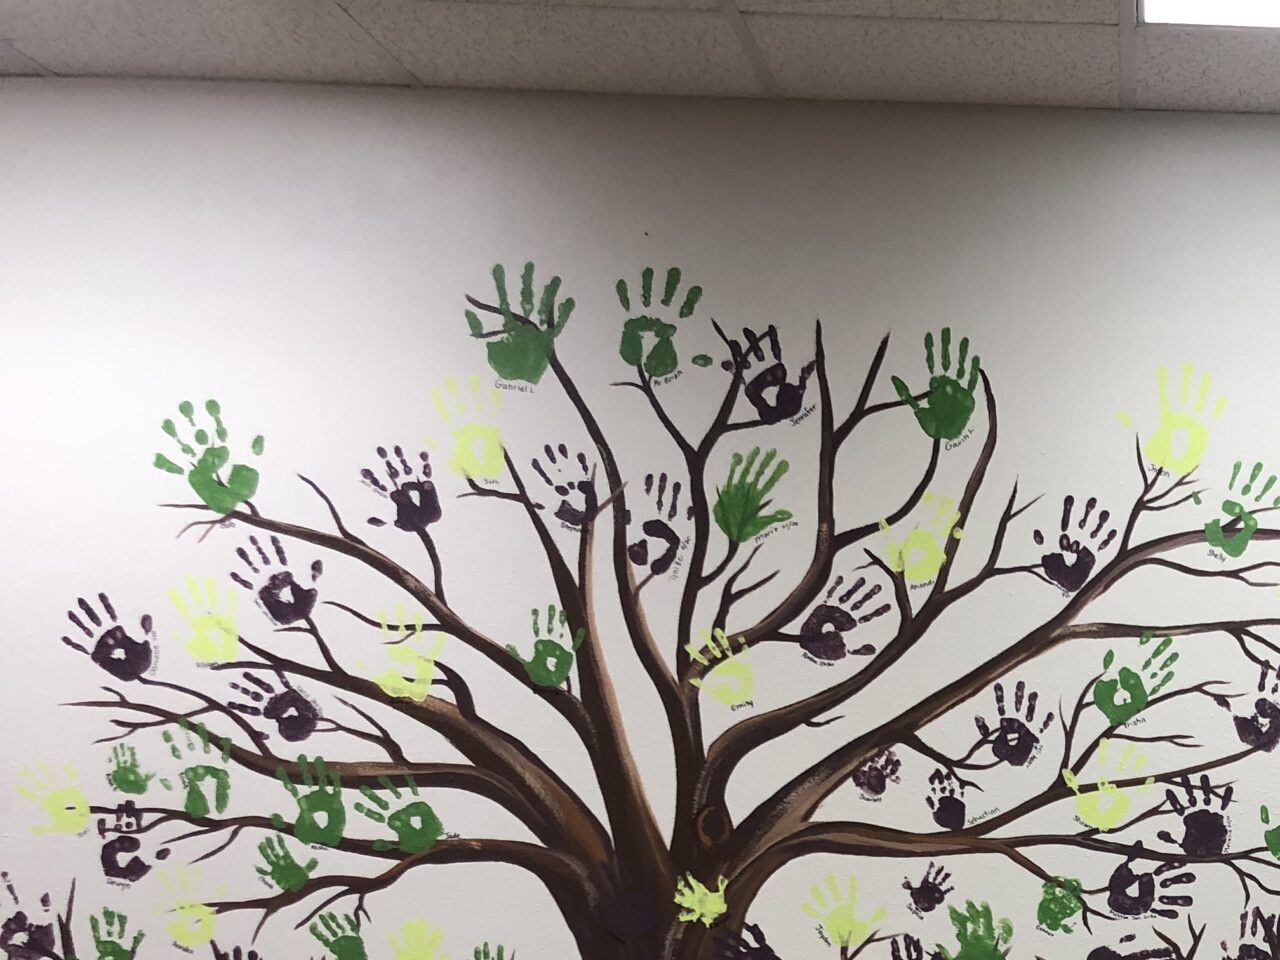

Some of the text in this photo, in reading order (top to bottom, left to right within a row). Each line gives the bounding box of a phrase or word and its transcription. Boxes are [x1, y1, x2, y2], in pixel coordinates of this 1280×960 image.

[664, 370, 683, 385] Brian
[495, 381, 528, 393] Gabriel
[791, 404, 816, 427] Jennifer
[945, 435, 969, 451] Gavin
[1207, 549, 1226, 562] Shelly
[731, 700, 754, 712] Emily
[967, 806, 1000, 824] Sebastian
